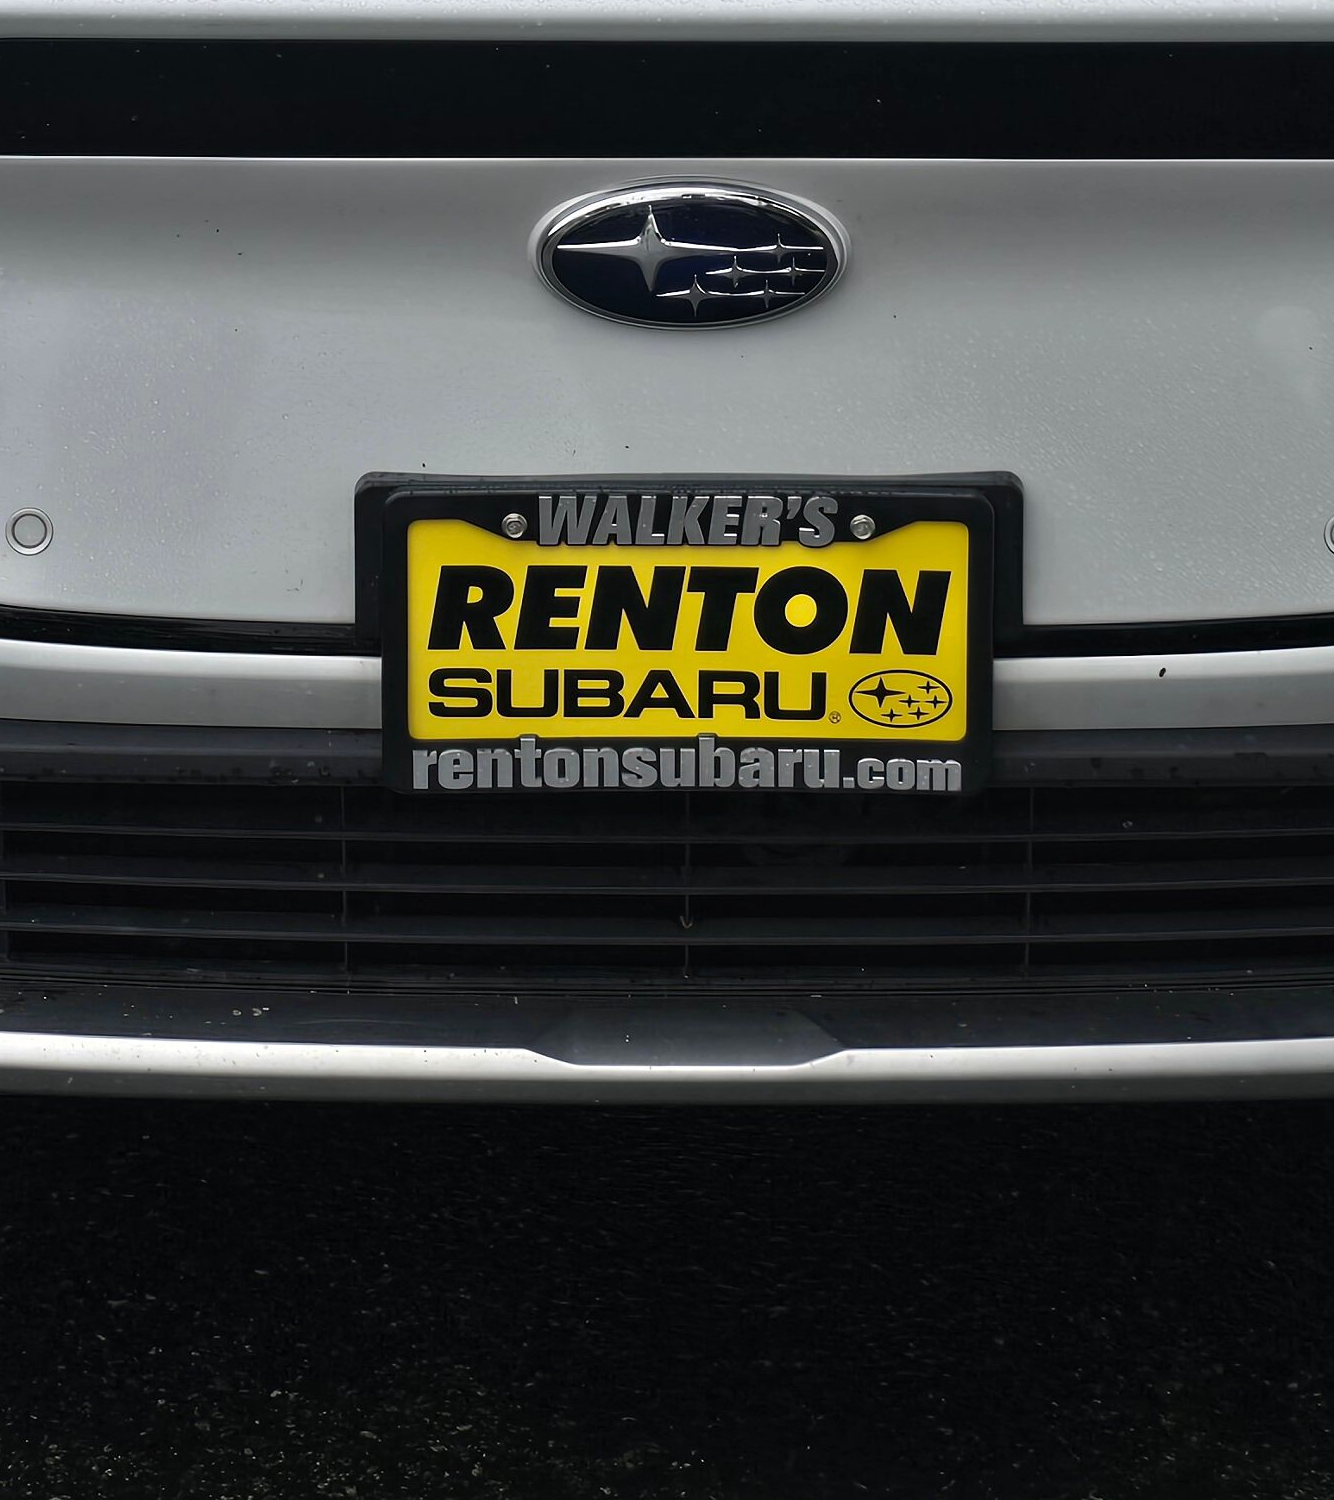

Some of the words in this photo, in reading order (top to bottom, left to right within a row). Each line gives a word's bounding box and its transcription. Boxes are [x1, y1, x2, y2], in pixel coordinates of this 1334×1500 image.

[538, 494, 839, 546] WALKER'S
[428, 565, 952, 655] RENTON
[428, 668, 827, 720] SUBARU
[411, 735, 963, 792] rentonsubaru.com
